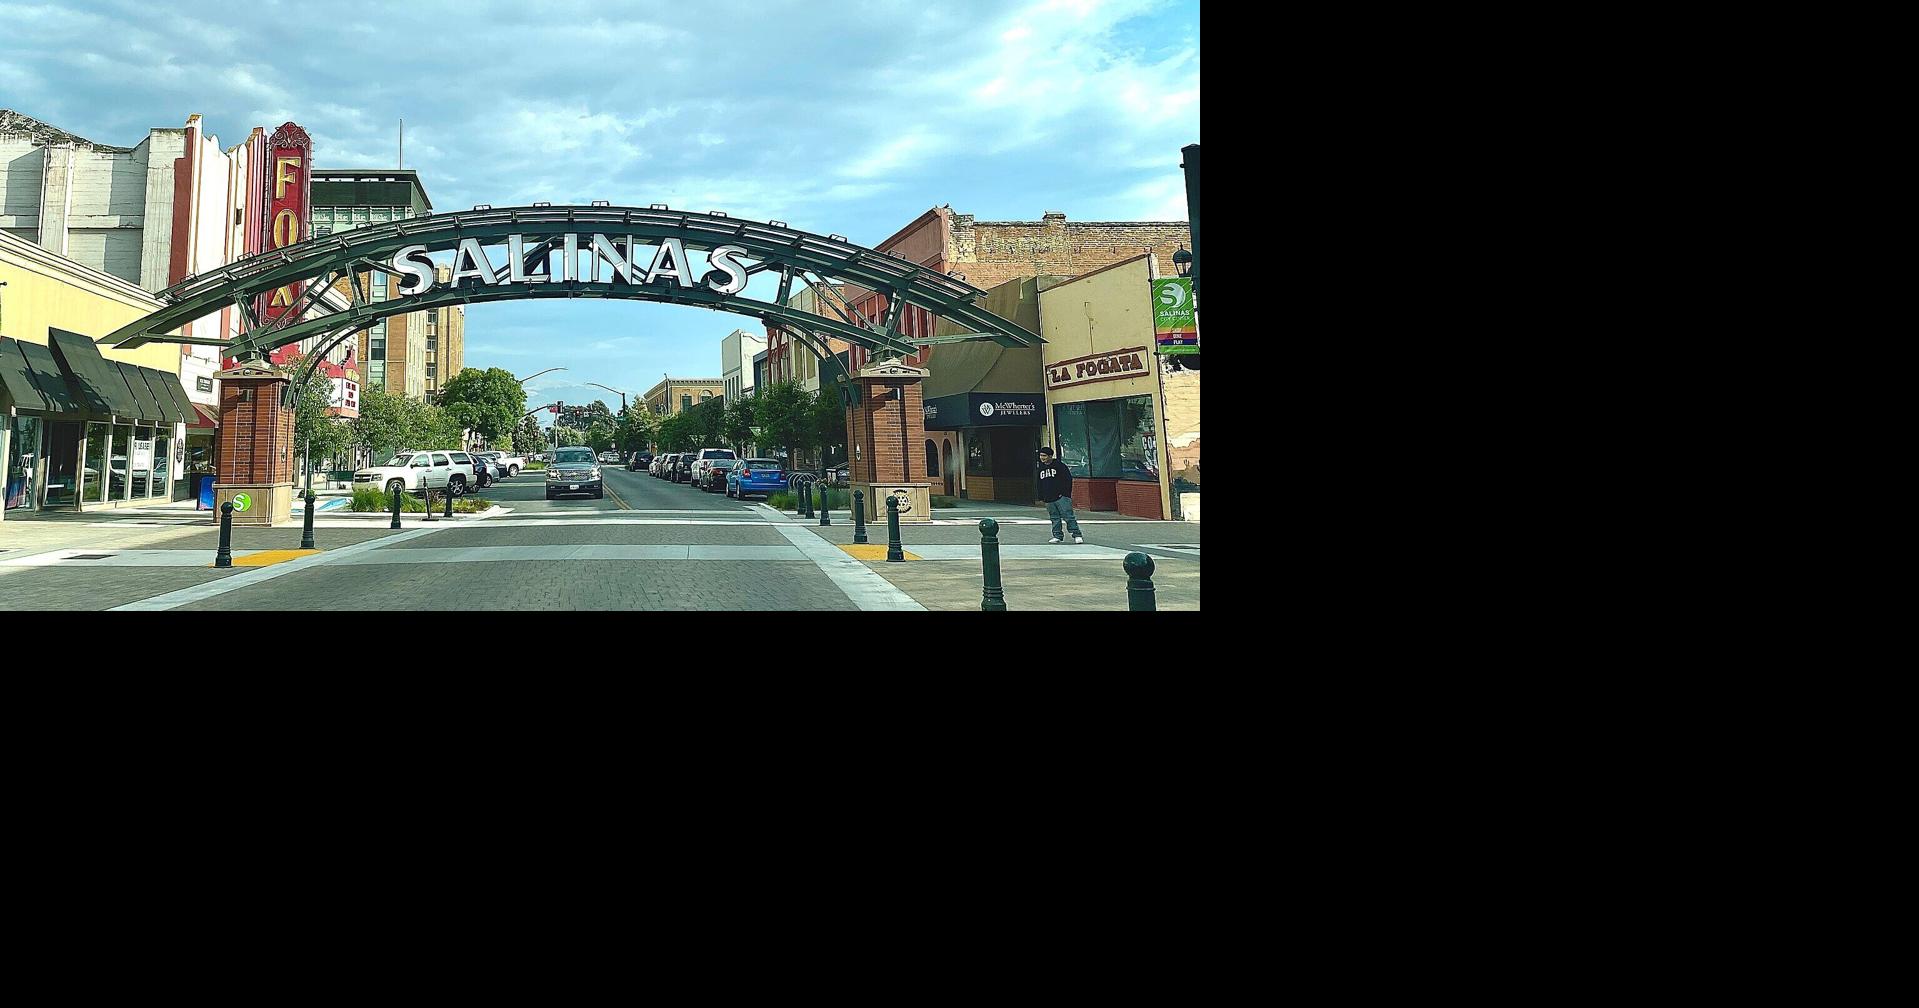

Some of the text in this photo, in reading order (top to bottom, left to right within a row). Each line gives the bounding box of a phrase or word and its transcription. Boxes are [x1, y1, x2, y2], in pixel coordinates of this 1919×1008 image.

[392, 232, 749, 297] SALINAS
[1051, 353, 1143, 383] LA FOGATA
[1040, 468, 1057, 480] GAP
